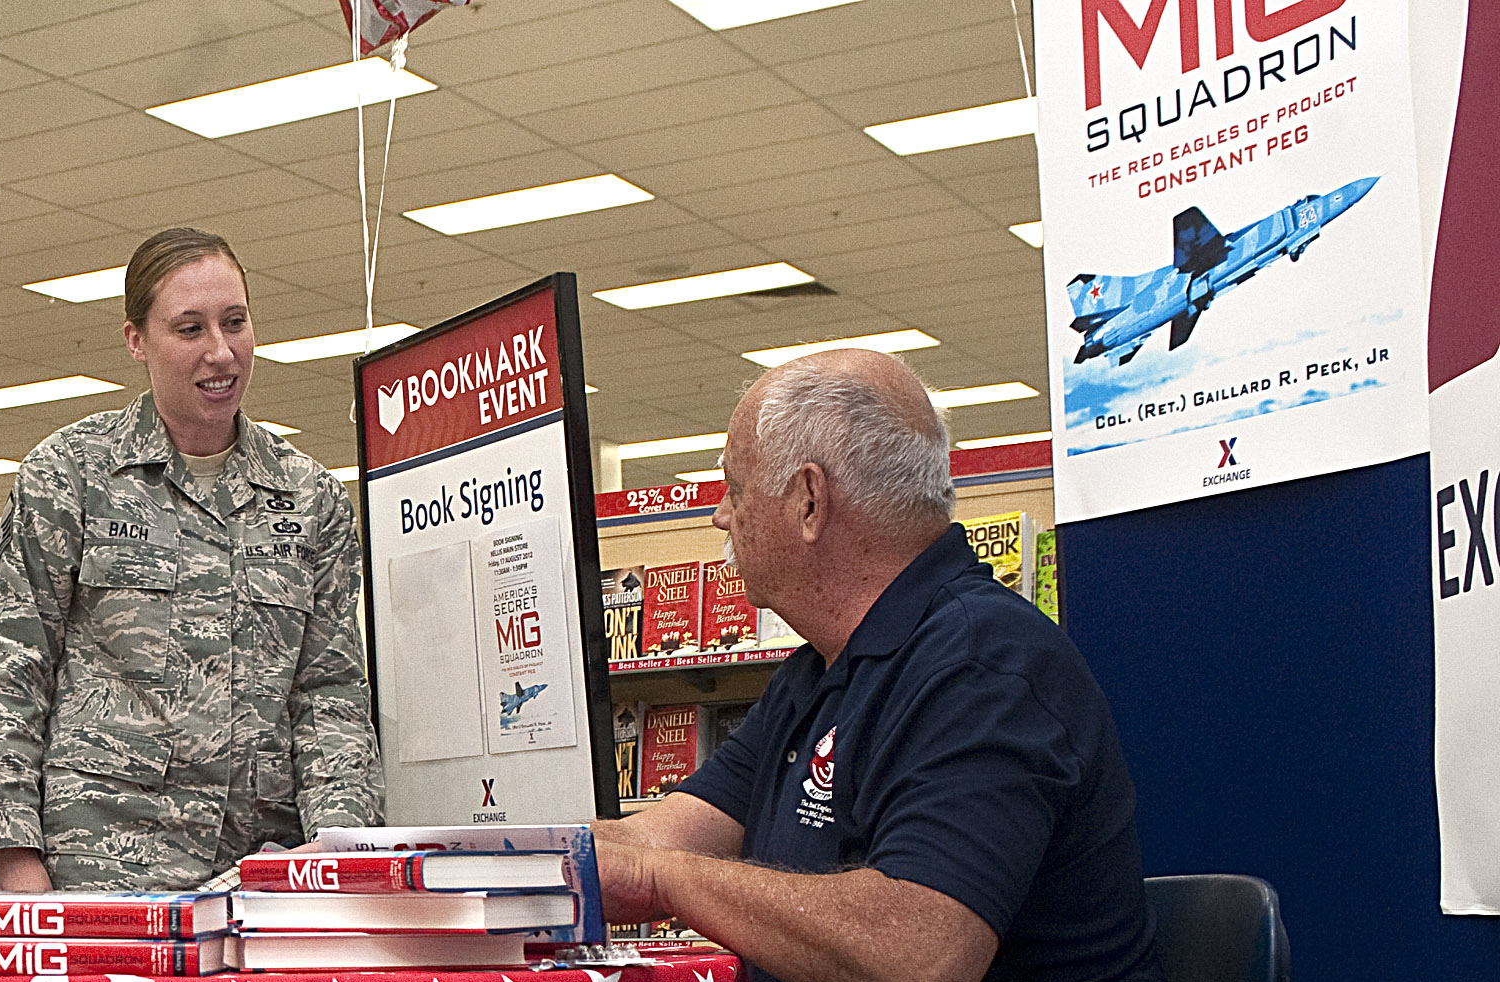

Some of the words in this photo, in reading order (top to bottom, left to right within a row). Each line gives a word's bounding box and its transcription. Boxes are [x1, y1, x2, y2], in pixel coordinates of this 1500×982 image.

[1081, 0, 1347, 111] Mi
[1086, 15, 1357, 153] SQUADRON
[1088, 166, 1121, 188] THE
[1128, 152, 1164, 176] RED
[1170, 125, 1240, 161] EAGLES
[1246, 114, 1270, 134] OF
[1276, 76, 1357, 123] PROJECT
[1138, 144, 1258, 199] CONSTANT
[1267, 125, 1309, 156] PEG
[407, 325, 547, 413] BOOKMARK
[1279, 370, 1298, 388] R.
[478, 368, 549, 425] EVENT
[1202, 469, 1251, 488] EXCHANGE
[400, 485, 455, 535] Book
[459, 467, 544, 526] Signing
[626, 488, 664, 508] 25%
[670, 483, 699, 502] Off
[638, 503, 663, 514] Cover
[664, 501, 689, 512] Price!
[108, 521, 149, 541] BACH
[965, 521, 1020, 543] ROBIN
[245, 546, 269, 558] U.S.
[273, 544, 291, 557] AIR
[975, 537, 1019, 559] OOK
[647, 567, 698, 588] DANIELLE
[493, 585, 537, 602] AMERICA'S
[657, 584, 689, 602] STEEL
[494, 596, 537, 616] SECRET
[711, 604, 735, 615] Happy
[603, 606, 642, 639] ON'T
[653, 609, 677, 623] Happy
[495, 611, 542, 653] MiG
[500, 648, 543, 664] SQUADRON
[610, 633, 638, 661] INK
[744, 652, 763, 660] Best
[765, 649, 790, 659] Seller
[618, 661, 635, 670] Best
[638, 659, 662, 669] Seller
[676, 657, 697, 666] Best
[698, 655, 721, 664] Seller
[647, 712, 695, 730] DANIELLE
[657, 728, 687, 744] STEEL
[652, 752, 675, 763] Happy
[473, 811, 507, 823] EXCHANGE
[287, 859, 340, 891] MiG
[66, 914, 139, 925] SQUADRON
[70, 954, 143, 965] SQUADRON
